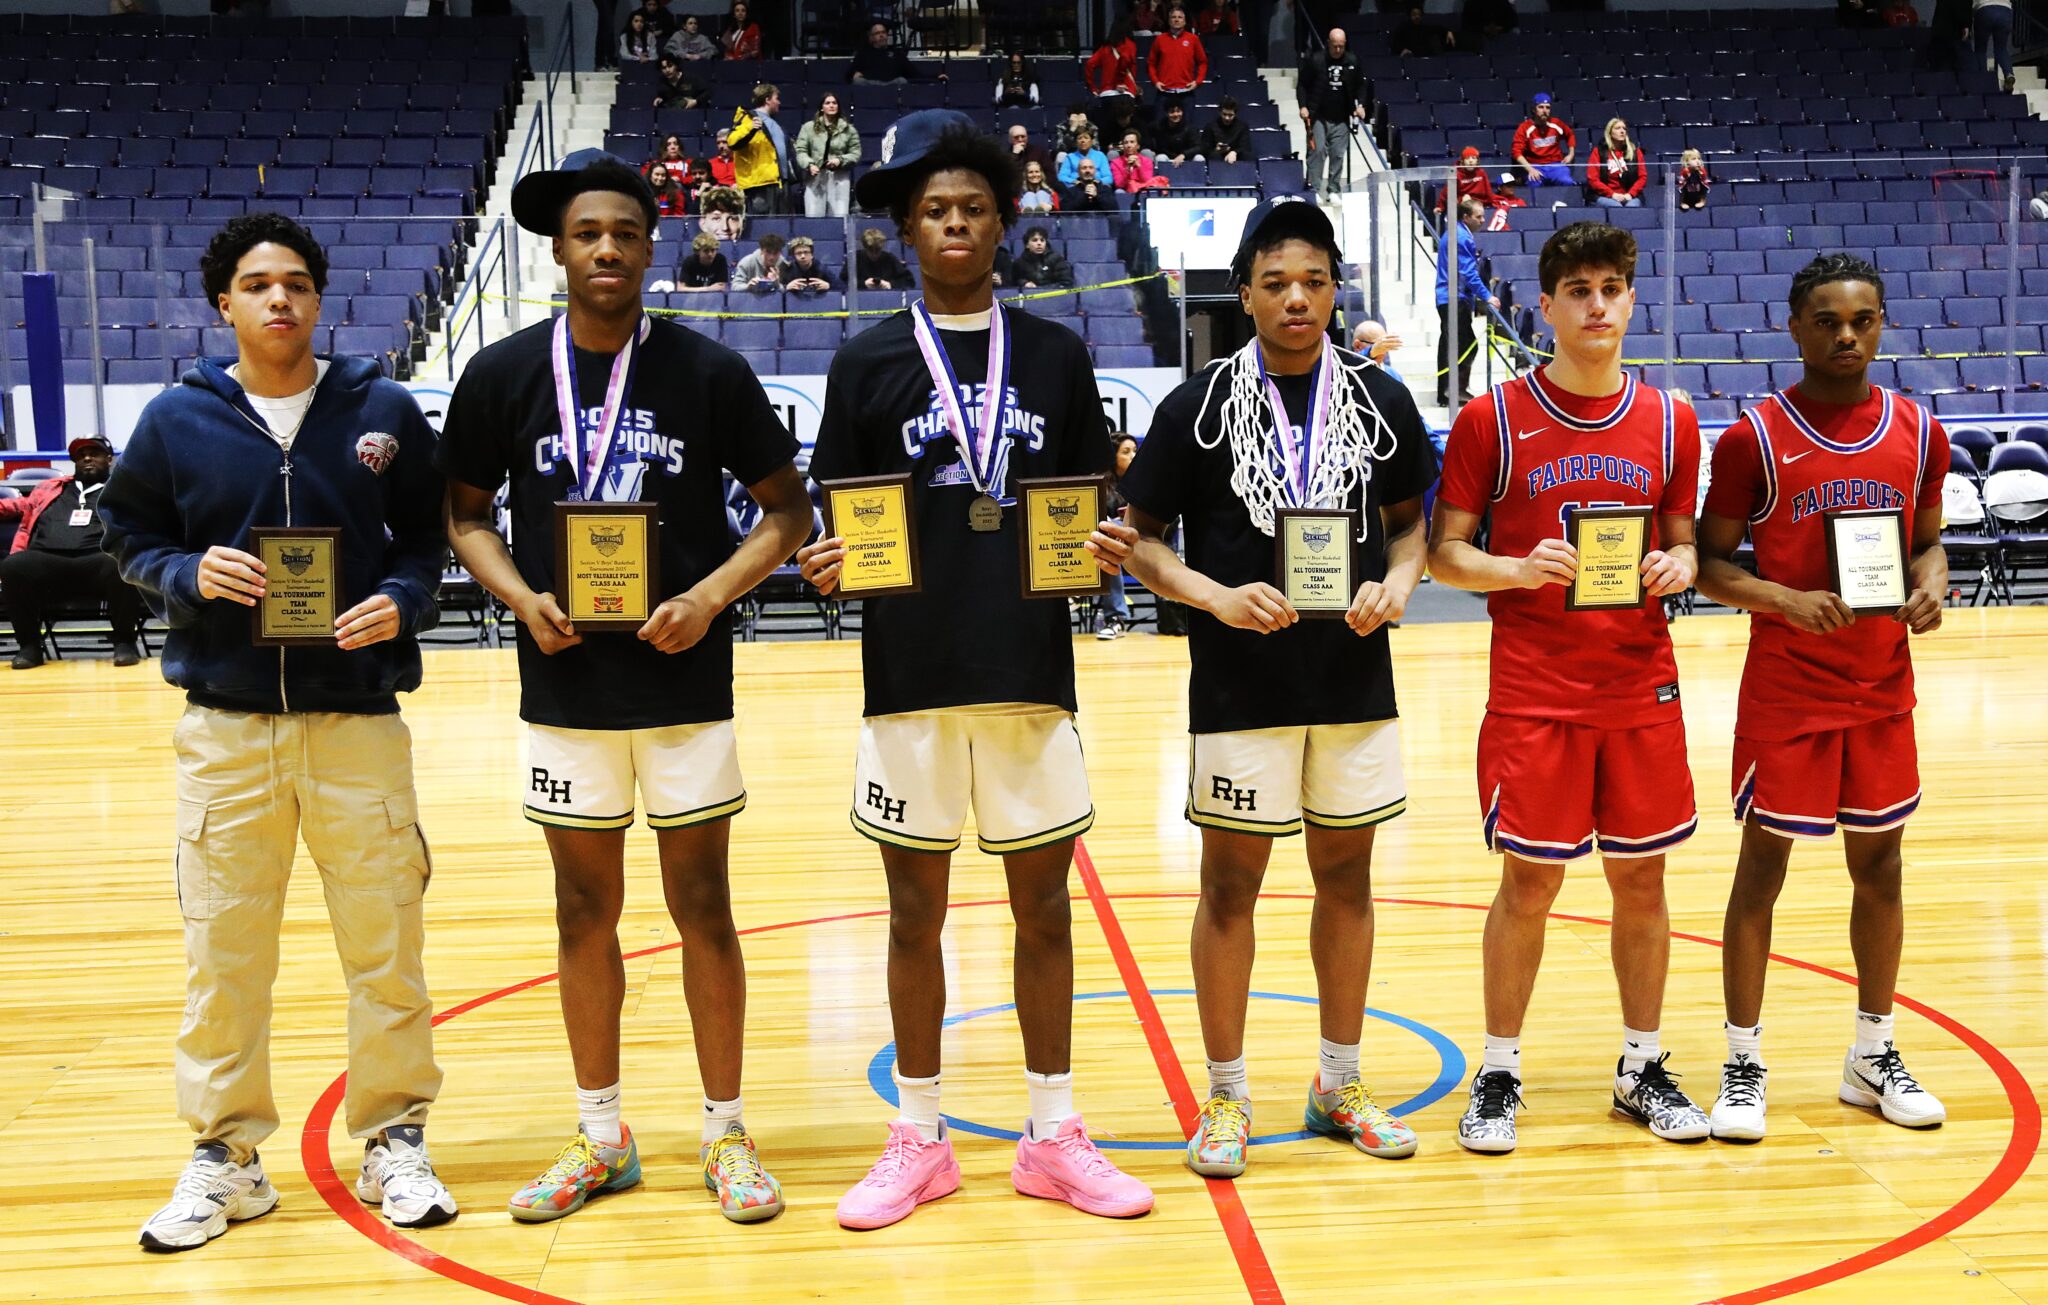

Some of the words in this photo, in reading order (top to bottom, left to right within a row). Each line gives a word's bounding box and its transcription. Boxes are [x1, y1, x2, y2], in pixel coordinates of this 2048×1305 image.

[935, 469, 968, 482] SECTION
[1527, 453, 1652, 500] FAIRPORT
[1791, 478, 1906, 524] FAIRPORT
[848, 541, 897, 552] SPORTSMANSHIP
[532, 767, 571, 803] RH
[867, 781, 906, 823] RH
[1212, 775, 1256, 811] RH
